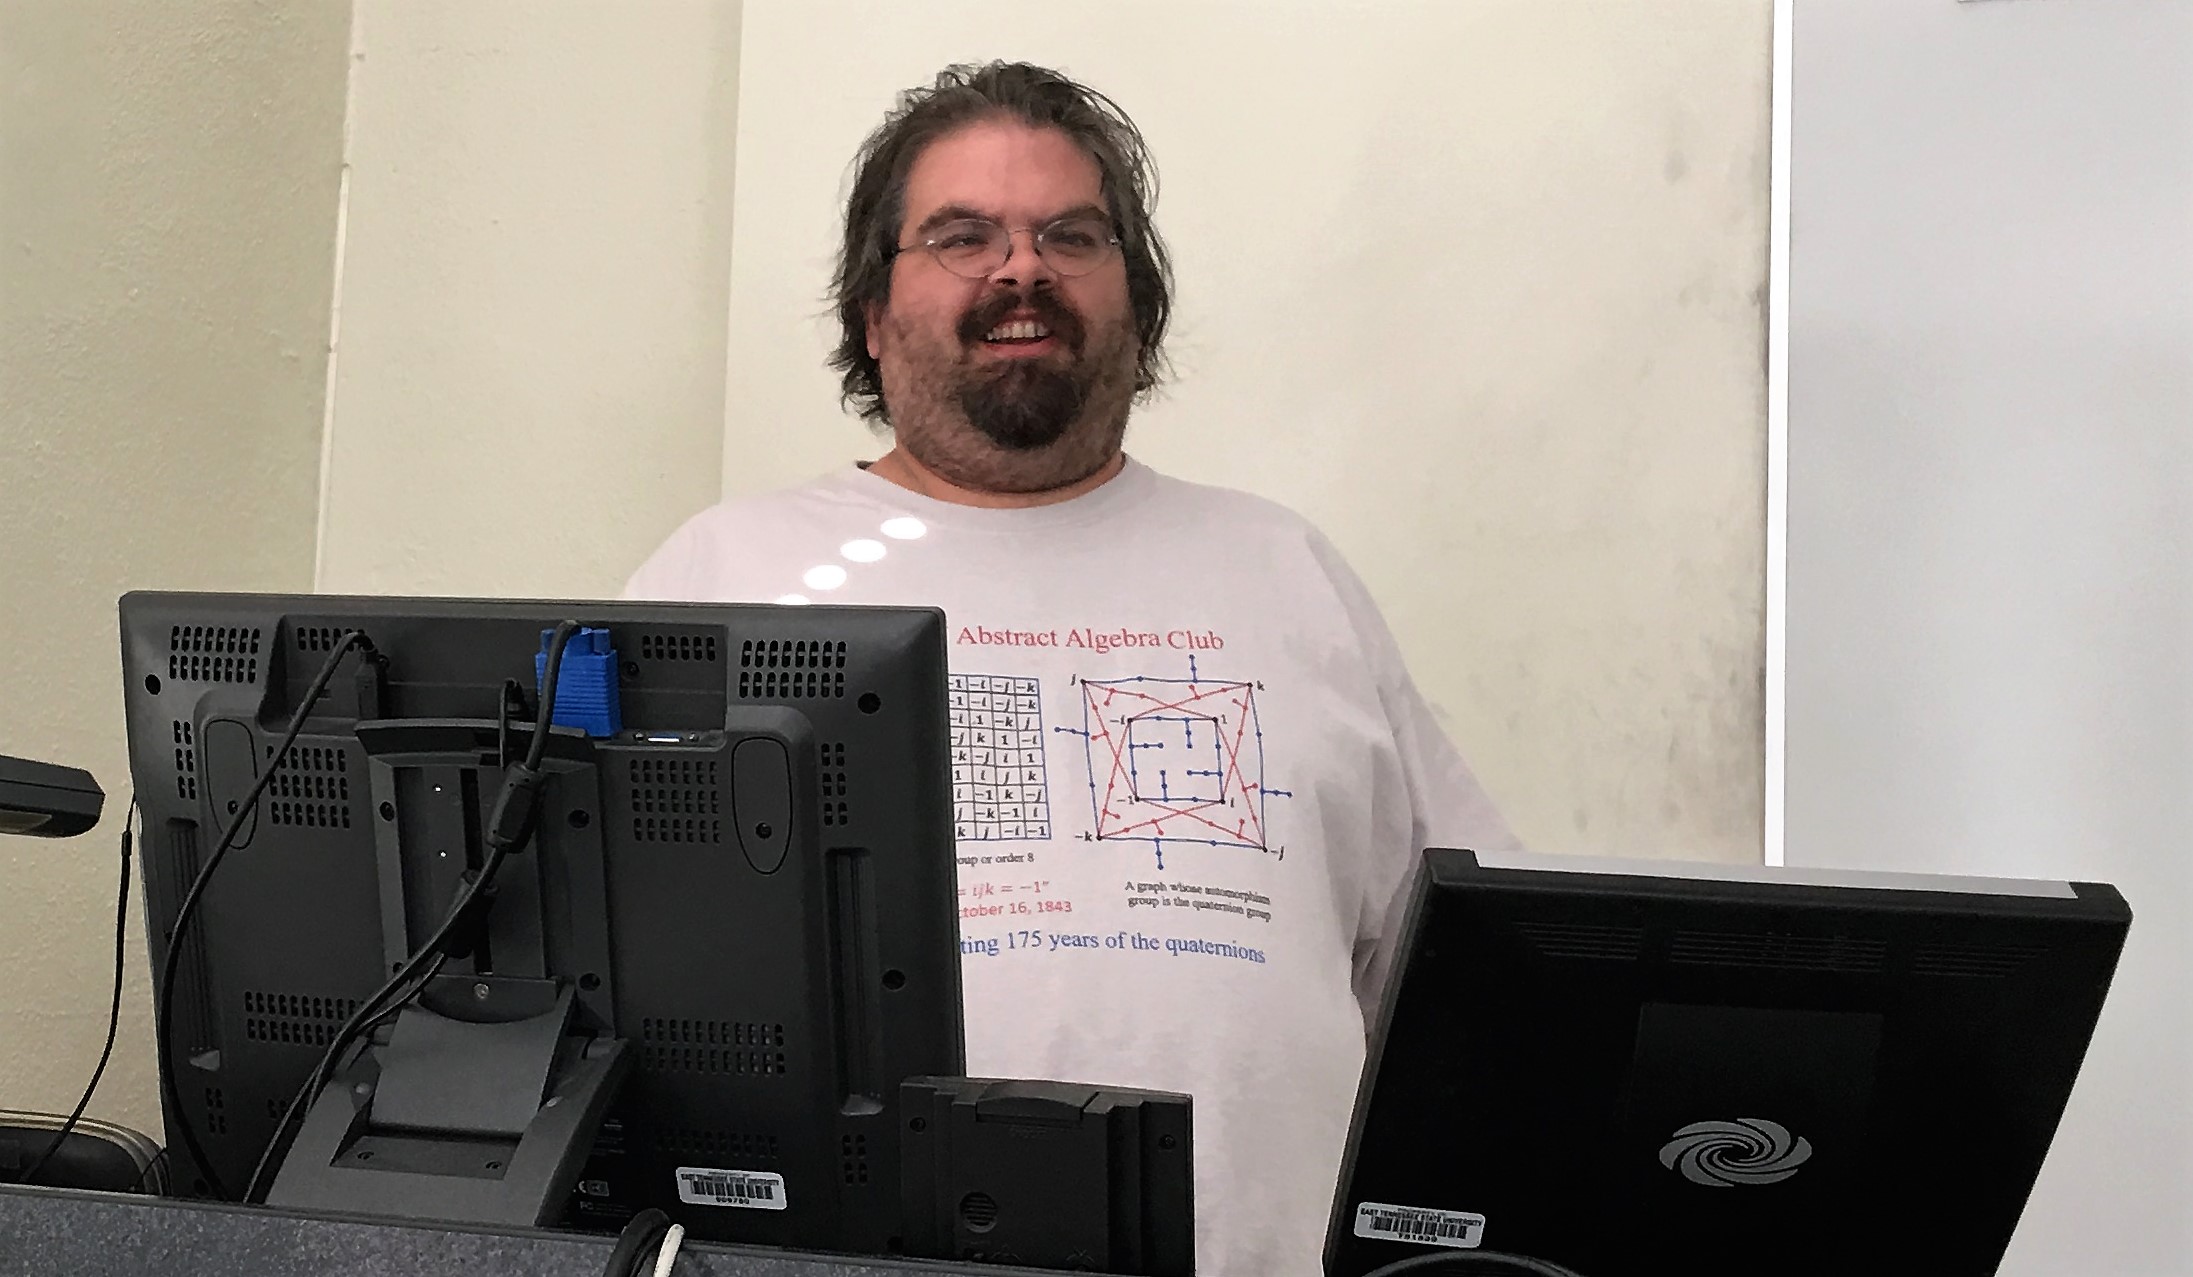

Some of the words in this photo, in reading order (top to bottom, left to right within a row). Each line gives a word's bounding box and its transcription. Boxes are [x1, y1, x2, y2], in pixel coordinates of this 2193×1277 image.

[957, 626, 1057, 647] Abstract
[1066, 628, 1161, 654] Algebra
[1167, 631, 1225, 650] Club
[1257, 682, 1265, 691] k
[976, 732, 985, 743] k
[1028, 770, 1036, 781] k
[1004, 788, 1013, 799] k
[957, 826, 966, 837] k
[956, 856, 978, 867] oup
[1027, 852, 1034, 862] 8
[1125, 881, 1135, 891] A
[1137, 882, 1167, 894] graph
[1009, 901, 1032, 915] 16,
[1037, 900, 1072, 913] 1843
[1128, 896, 1159, 908] group
[1162, 896, 1171, 906] is
[1174, 896, 1190, 907] the
[1192, 900, 1244, 914] quaternion
[1008, 930, 1042, 949] 175
[1049, 933, 1099, 951] years
[1105, 931, 1127, 949] of
[1131, 932, 1160, 950] the
[1165, 937, 1266, 964] quaternions
